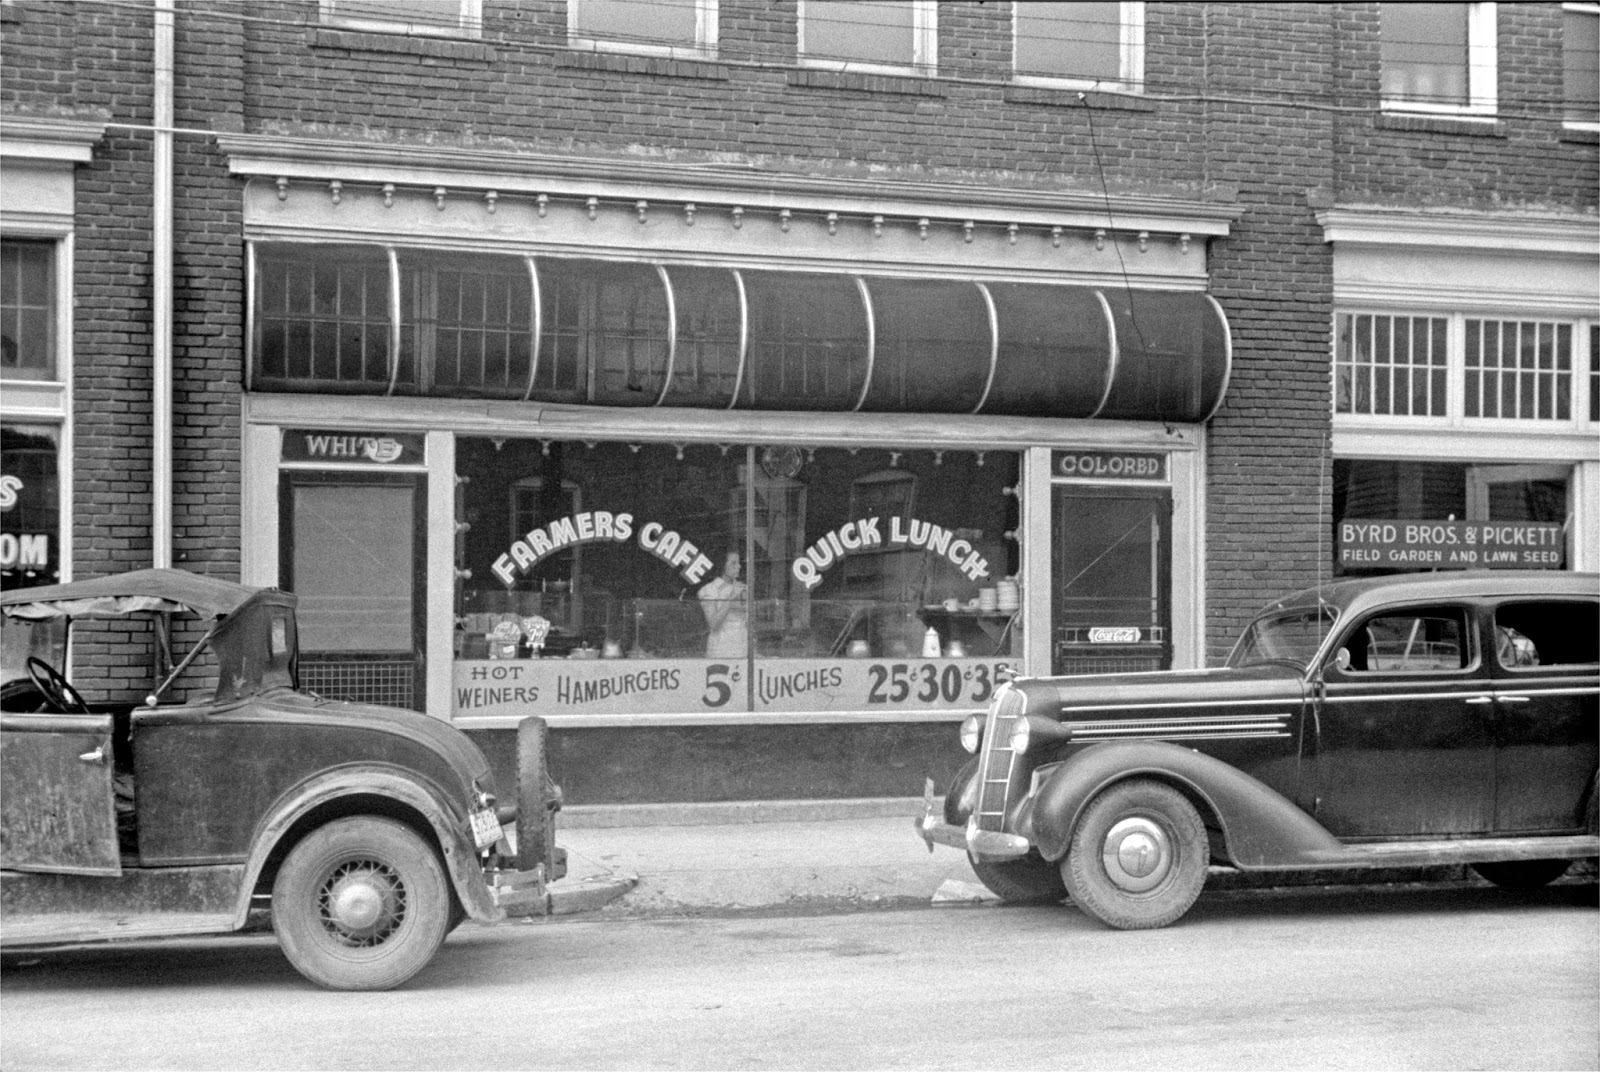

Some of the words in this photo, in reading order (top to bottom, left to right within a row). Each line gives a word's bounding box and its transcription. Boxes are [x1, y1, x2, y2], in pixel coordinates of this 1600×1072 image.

[1061, 455, 1159, 474] COLORED
[1342, 524, 1397, 544] BYRD
[1405, 525, 1461, 545] BROS.
[1465, 526, 1478, 545] &
[1483, 527, 1559, 546] PICKETT
[490, 511, 634, 586] FARMERS
[638, 522, 714, 585] CAFE
[792, 516, 882, 589] QUICK
[890, 516, 990, 581] LUNCH
[1342, 549, 1381, 562] FIELD
[1388, 550, 1443, 562] GARDEN
[1449, 550, 1478, 562] AND
[1483, 551, 1518, 563] LAWN
[1523, 551, 1559, 563] SEED
[471, 666, 524, 681] HOT
[556, 669, 681, 705] HAMBURGERS
[758, 667, 842, 705] LUNCHES
[457, 687, 540, 709] WEINERS
